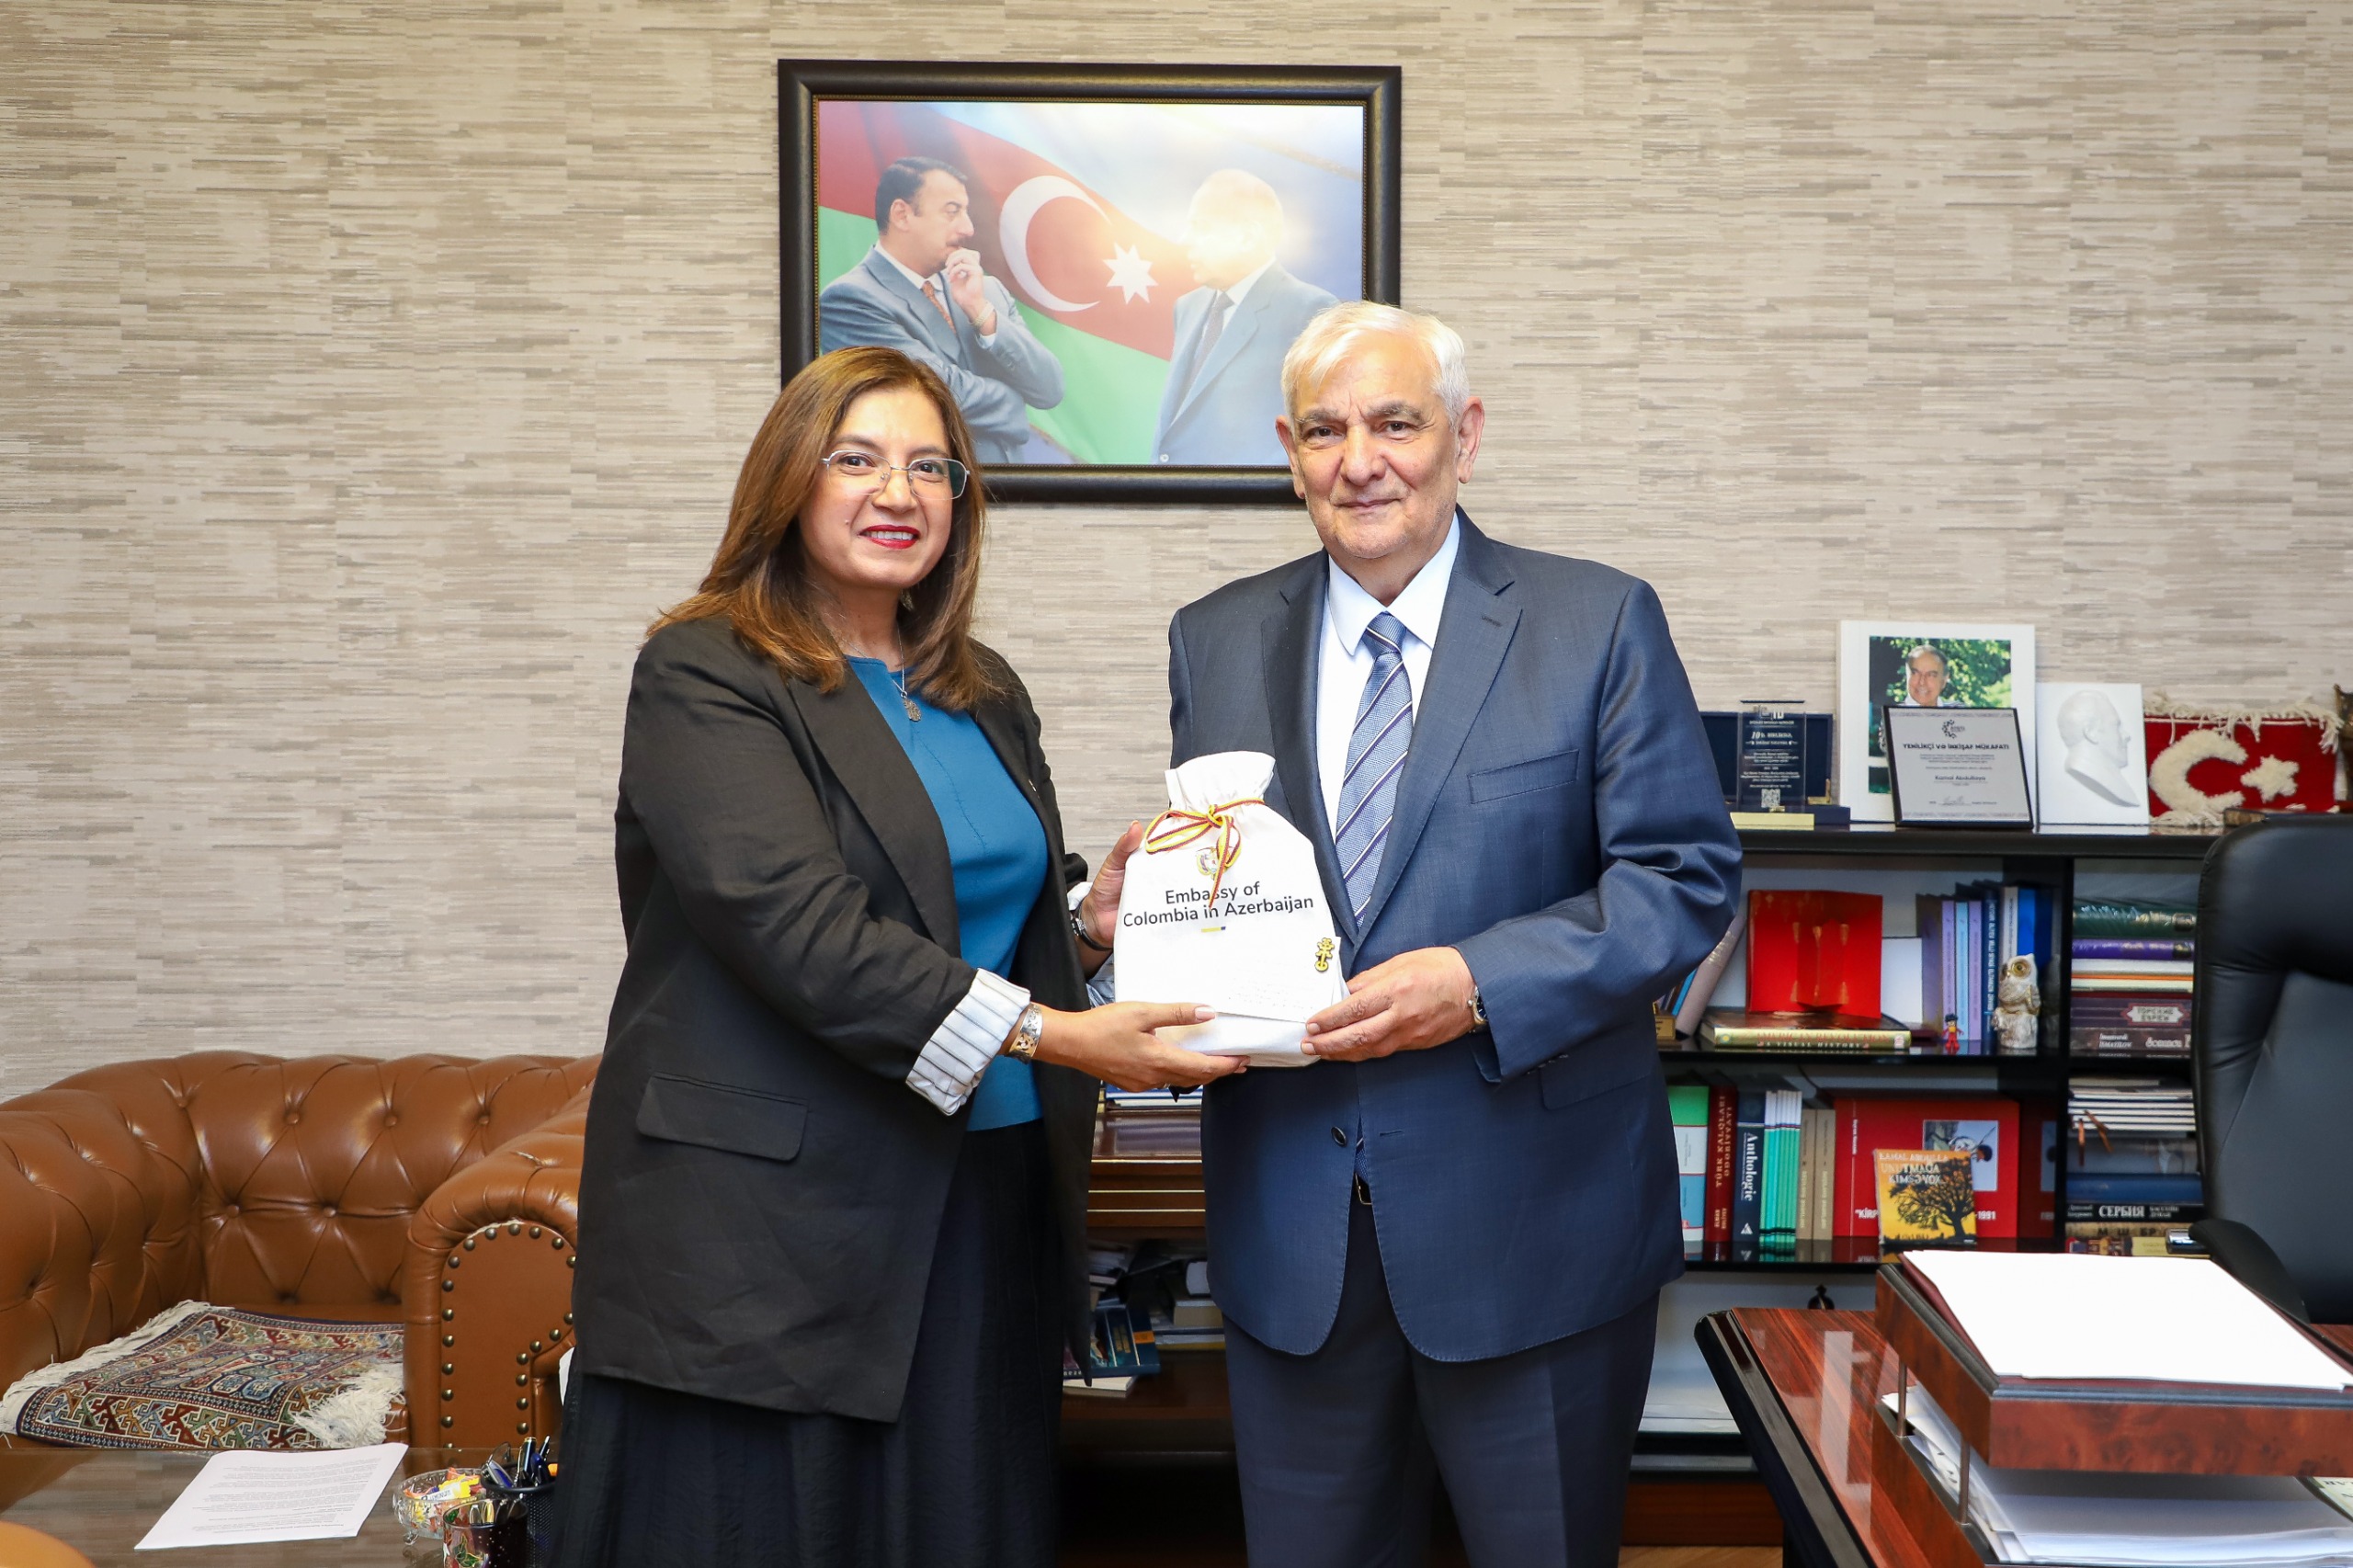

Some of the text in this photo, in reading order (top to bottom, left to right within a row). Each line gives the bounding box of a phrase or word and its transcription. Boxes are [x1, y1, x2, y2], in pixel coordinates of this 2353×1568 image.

[1243, 881, 1261, 897] of
[1123, 895, 1314, 927] Colombia in Azerbaijan
[1742, 1131, 1759, 1201] Anthologie
[2098, 1205, 2145, 1218] СЕРБИЯ
